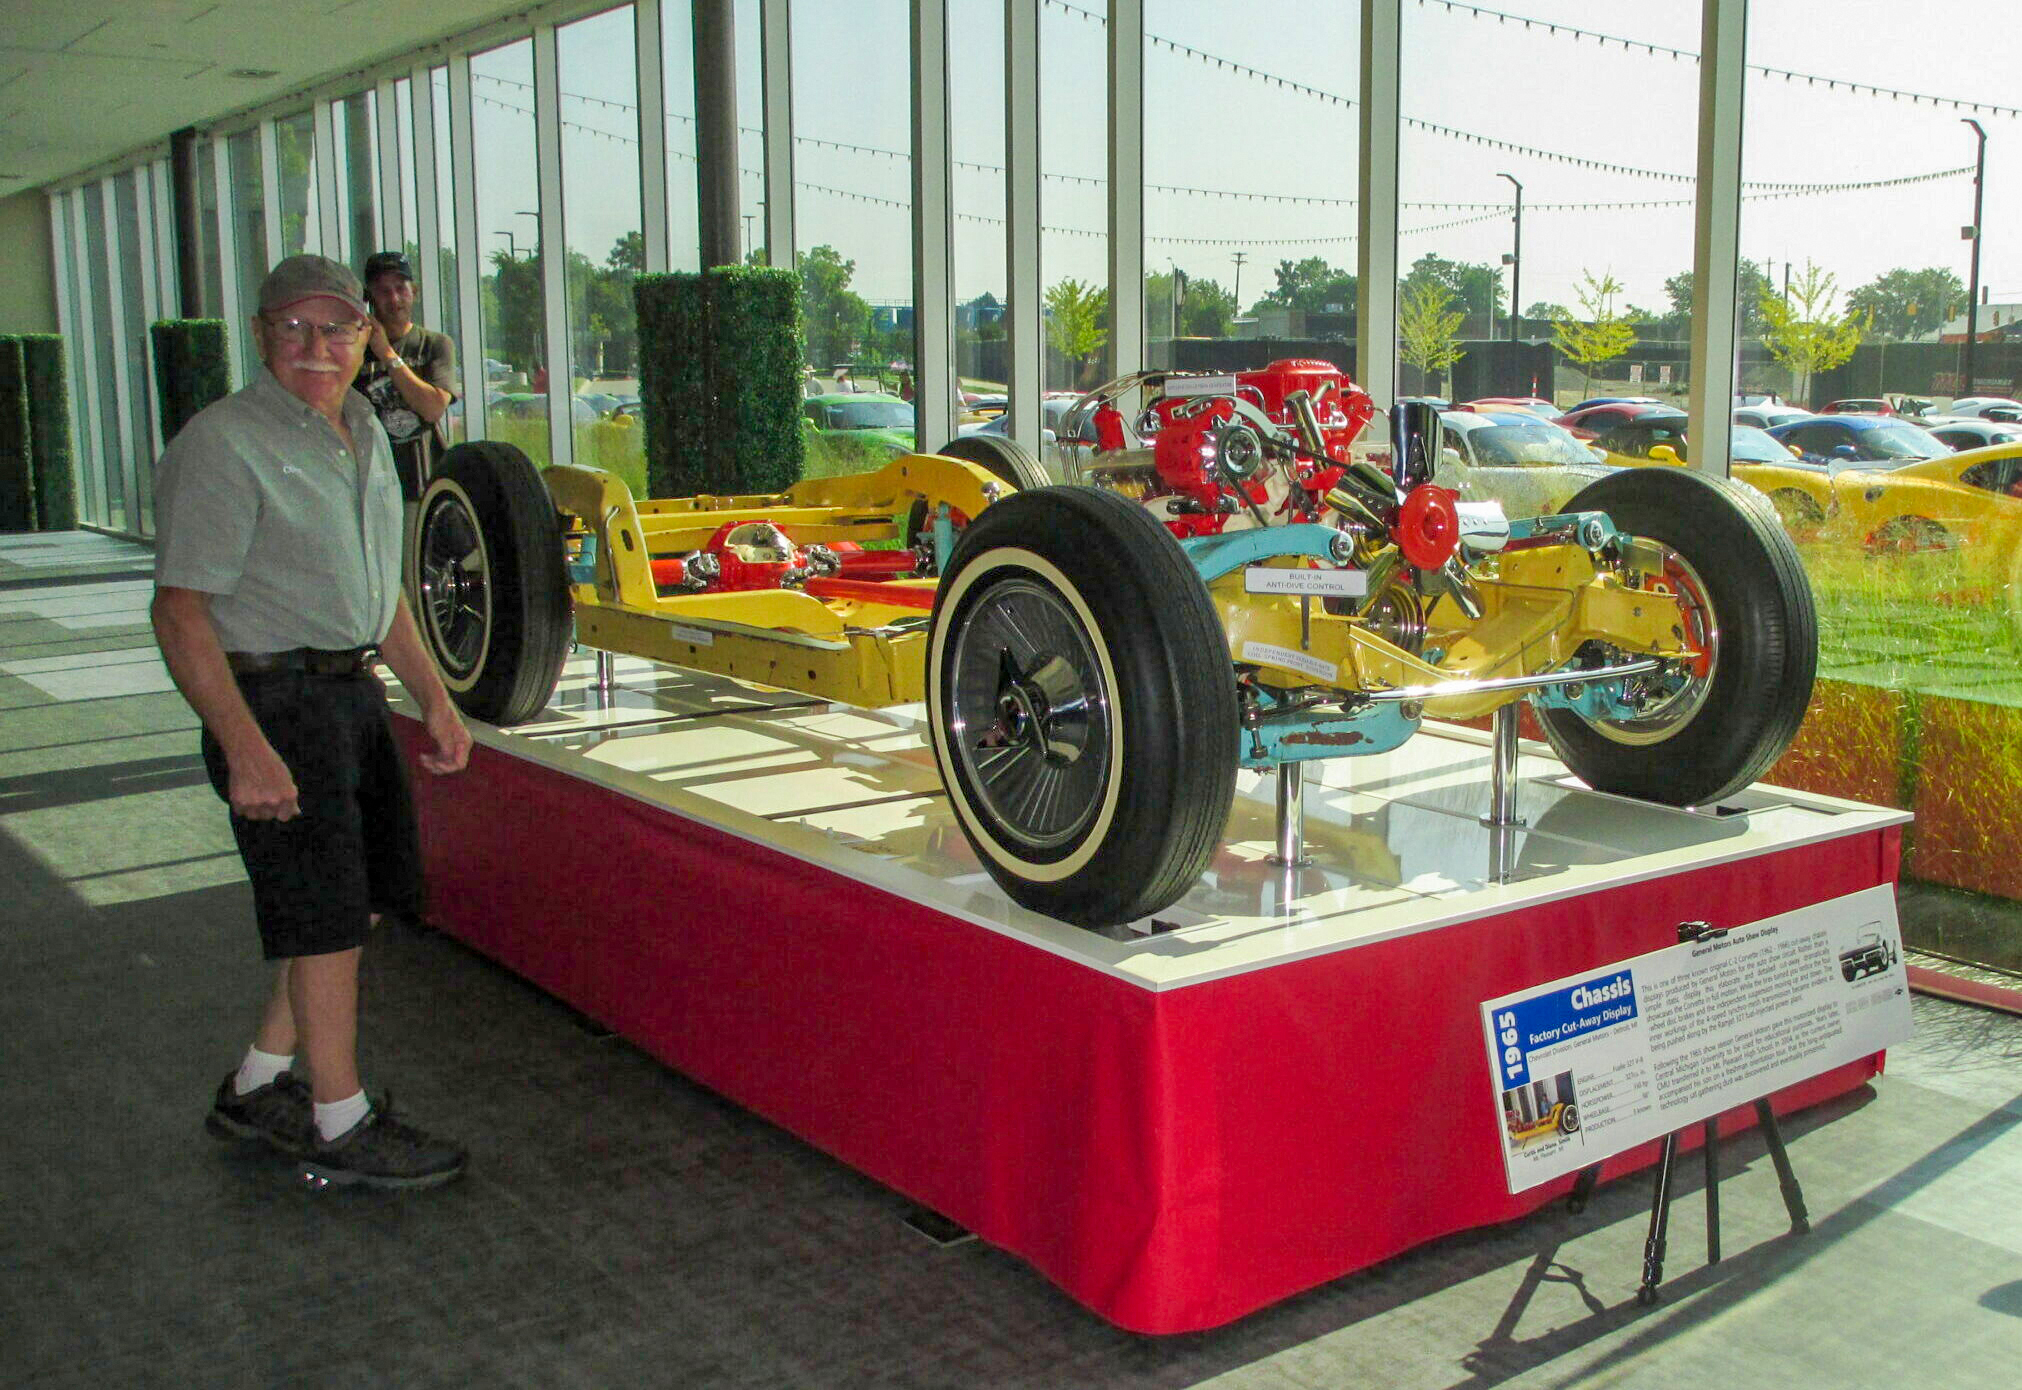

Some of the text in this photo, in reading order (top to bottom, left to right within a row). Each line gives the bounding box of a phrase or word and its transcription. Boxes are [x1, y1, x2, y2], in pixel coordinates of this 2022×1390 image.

[1266, 581, 1304, 589] ANTI-DIVE
[1691, 925, 1778, 957] General Motors Auto Show Display
[1571, 976, 1632, 1010] Chassis
[1529, 1004, 1631, 1046] Factory Cut-Away Display
[1499, 1011, 1523, 1080] 1965
